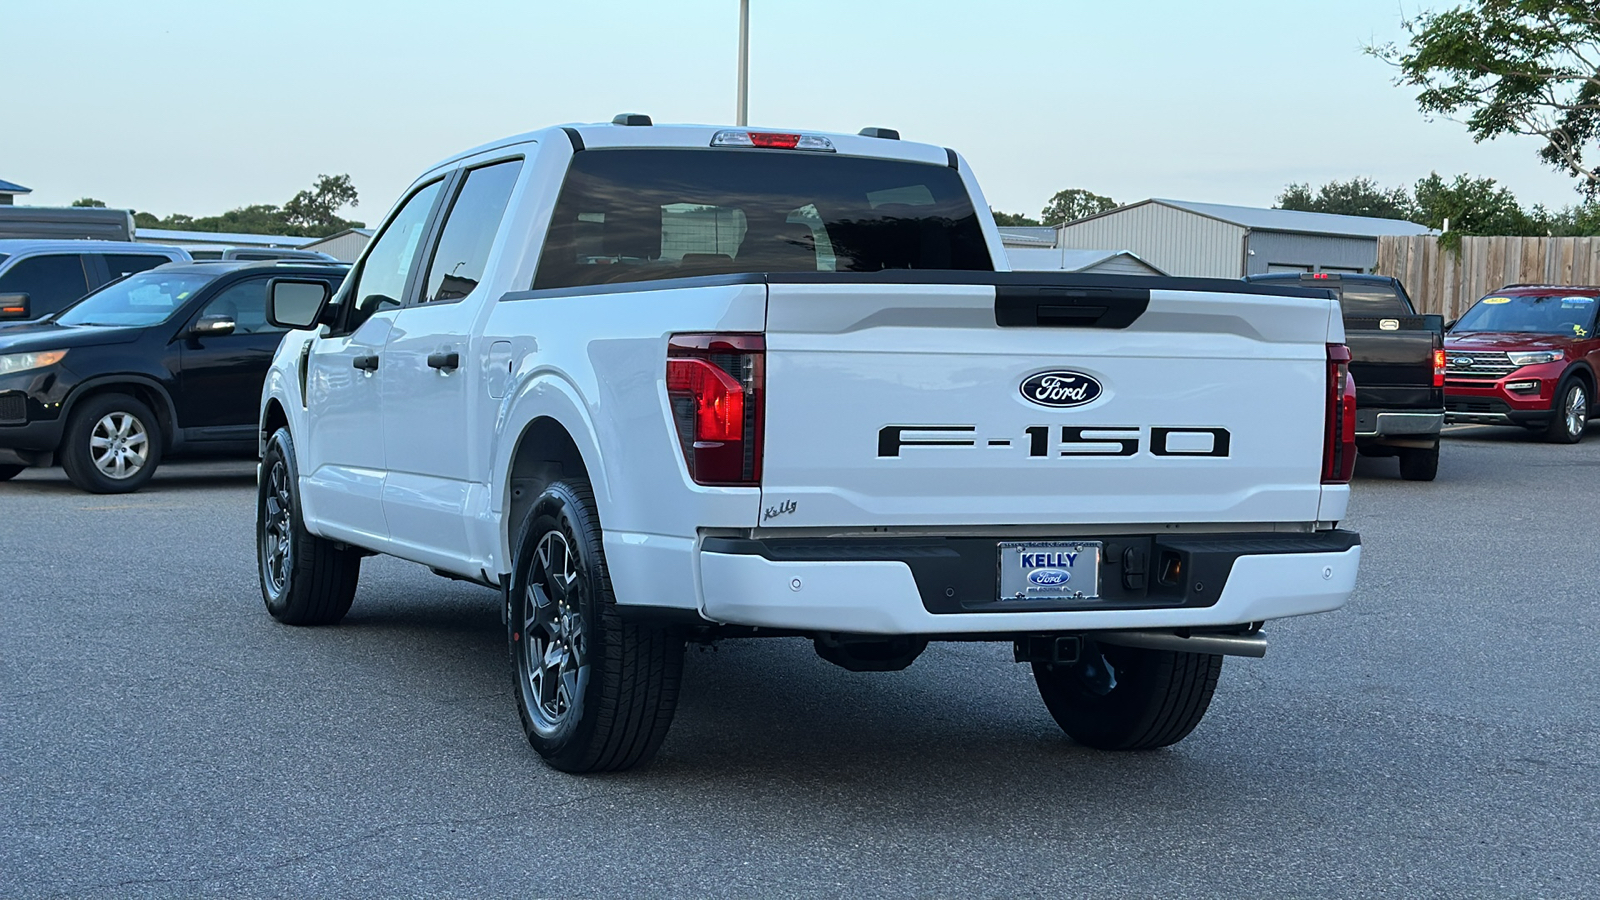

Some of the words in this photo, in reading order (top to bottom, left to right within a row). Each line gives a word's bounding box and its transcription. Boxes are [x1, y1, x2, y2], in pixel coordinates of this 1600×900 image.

[1036, 375, 1088, 401] Ford
[877, 425, 1232, 458] F-150
[763, 499, 798, 522] Kelly
[1021, 553, 1078, 568] KELLY
[1036, 570, 1062, 583] Ford
